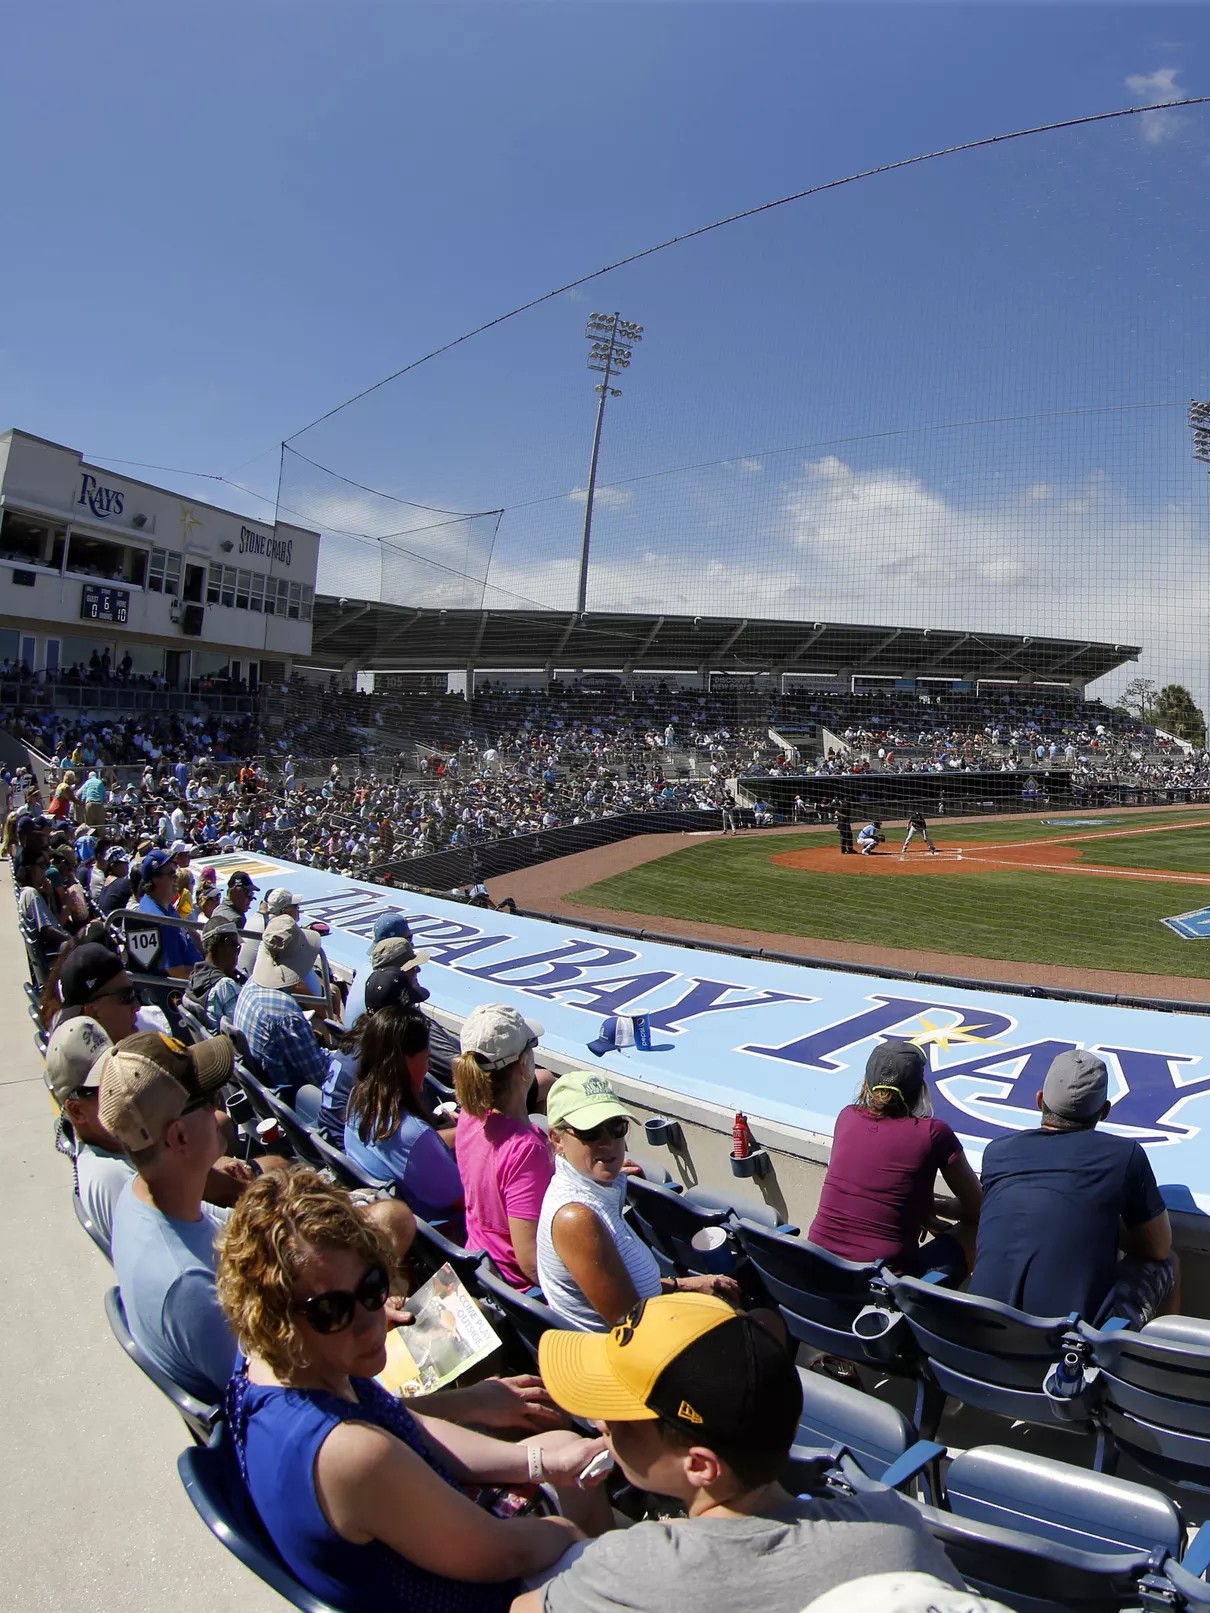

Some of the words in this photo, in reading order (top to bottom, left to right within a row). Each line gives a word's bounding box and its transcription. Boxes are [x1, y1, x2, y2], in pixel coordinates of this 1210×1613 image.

[77, 473, 125, 518] RAYS
[239, 525, 266, 554] STONE
[266, 538, 293, 566] CRABS
[91, 603, 98, 618] 0
[117, 608, 128, 622] 10
[104, 597, 111, 610] 6
[131, 932, 157, 949] 104
[453, 938, 822, 1036] BAY
[639, 1027, 648, 1047] pepsi
